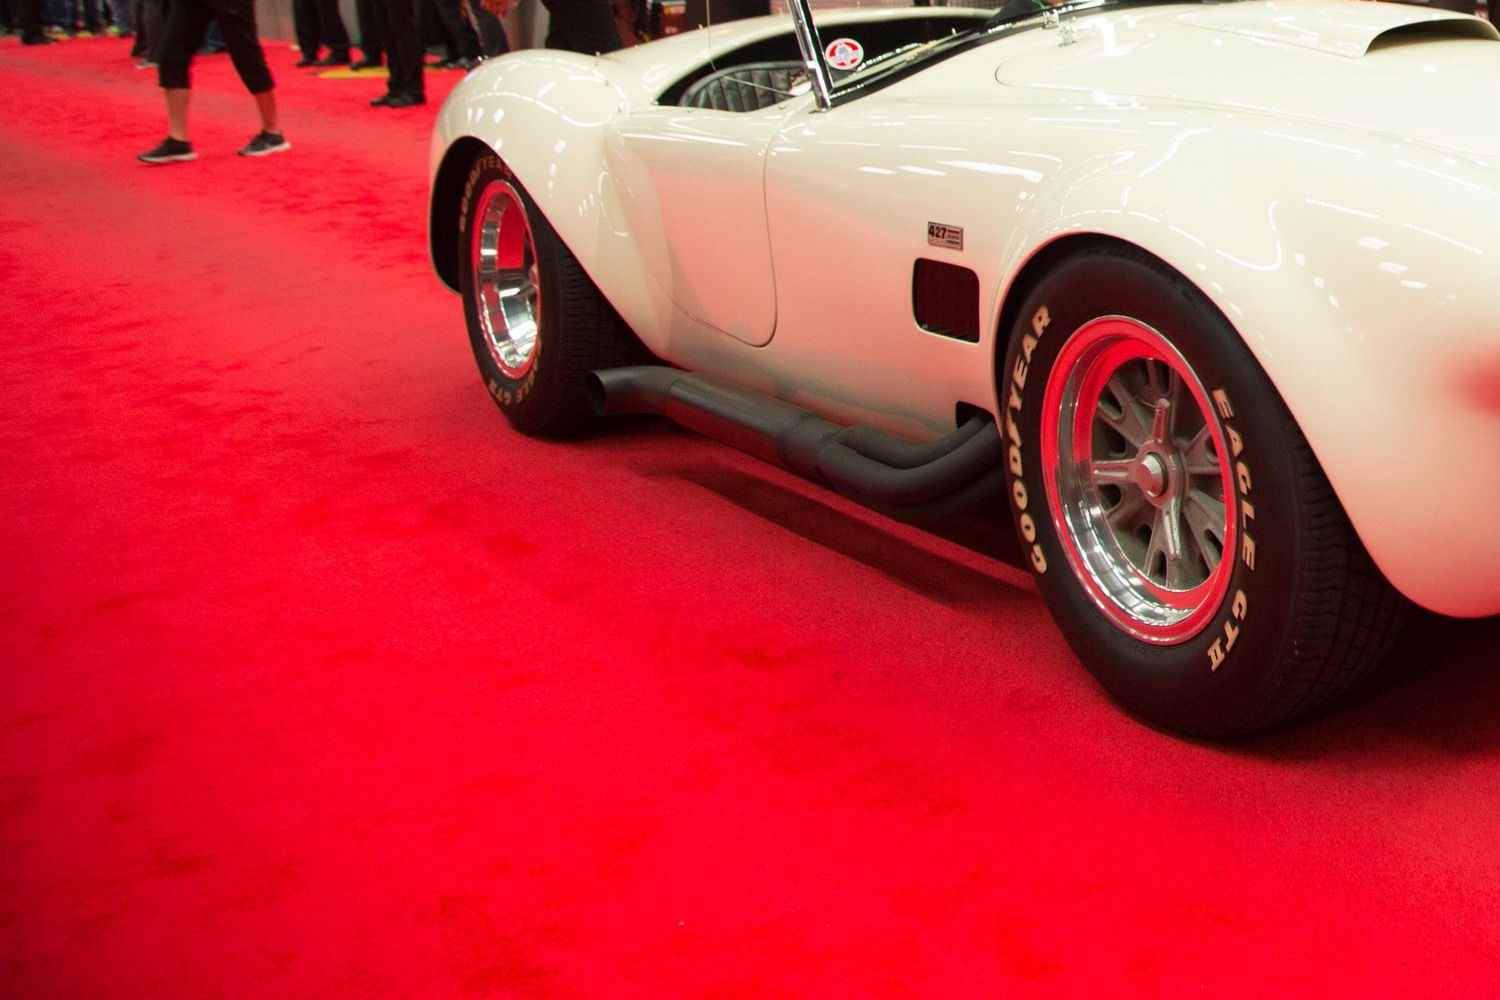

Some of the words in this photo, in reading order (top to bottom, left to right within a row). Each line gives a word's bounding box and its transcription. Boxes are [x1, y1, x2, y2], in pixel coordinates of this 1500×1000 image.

[928, 225, 947, 240] 427
[1007, 305, 1051, 574] GOODYEAR
[1211, 388, 1256, 572] EAGLE
